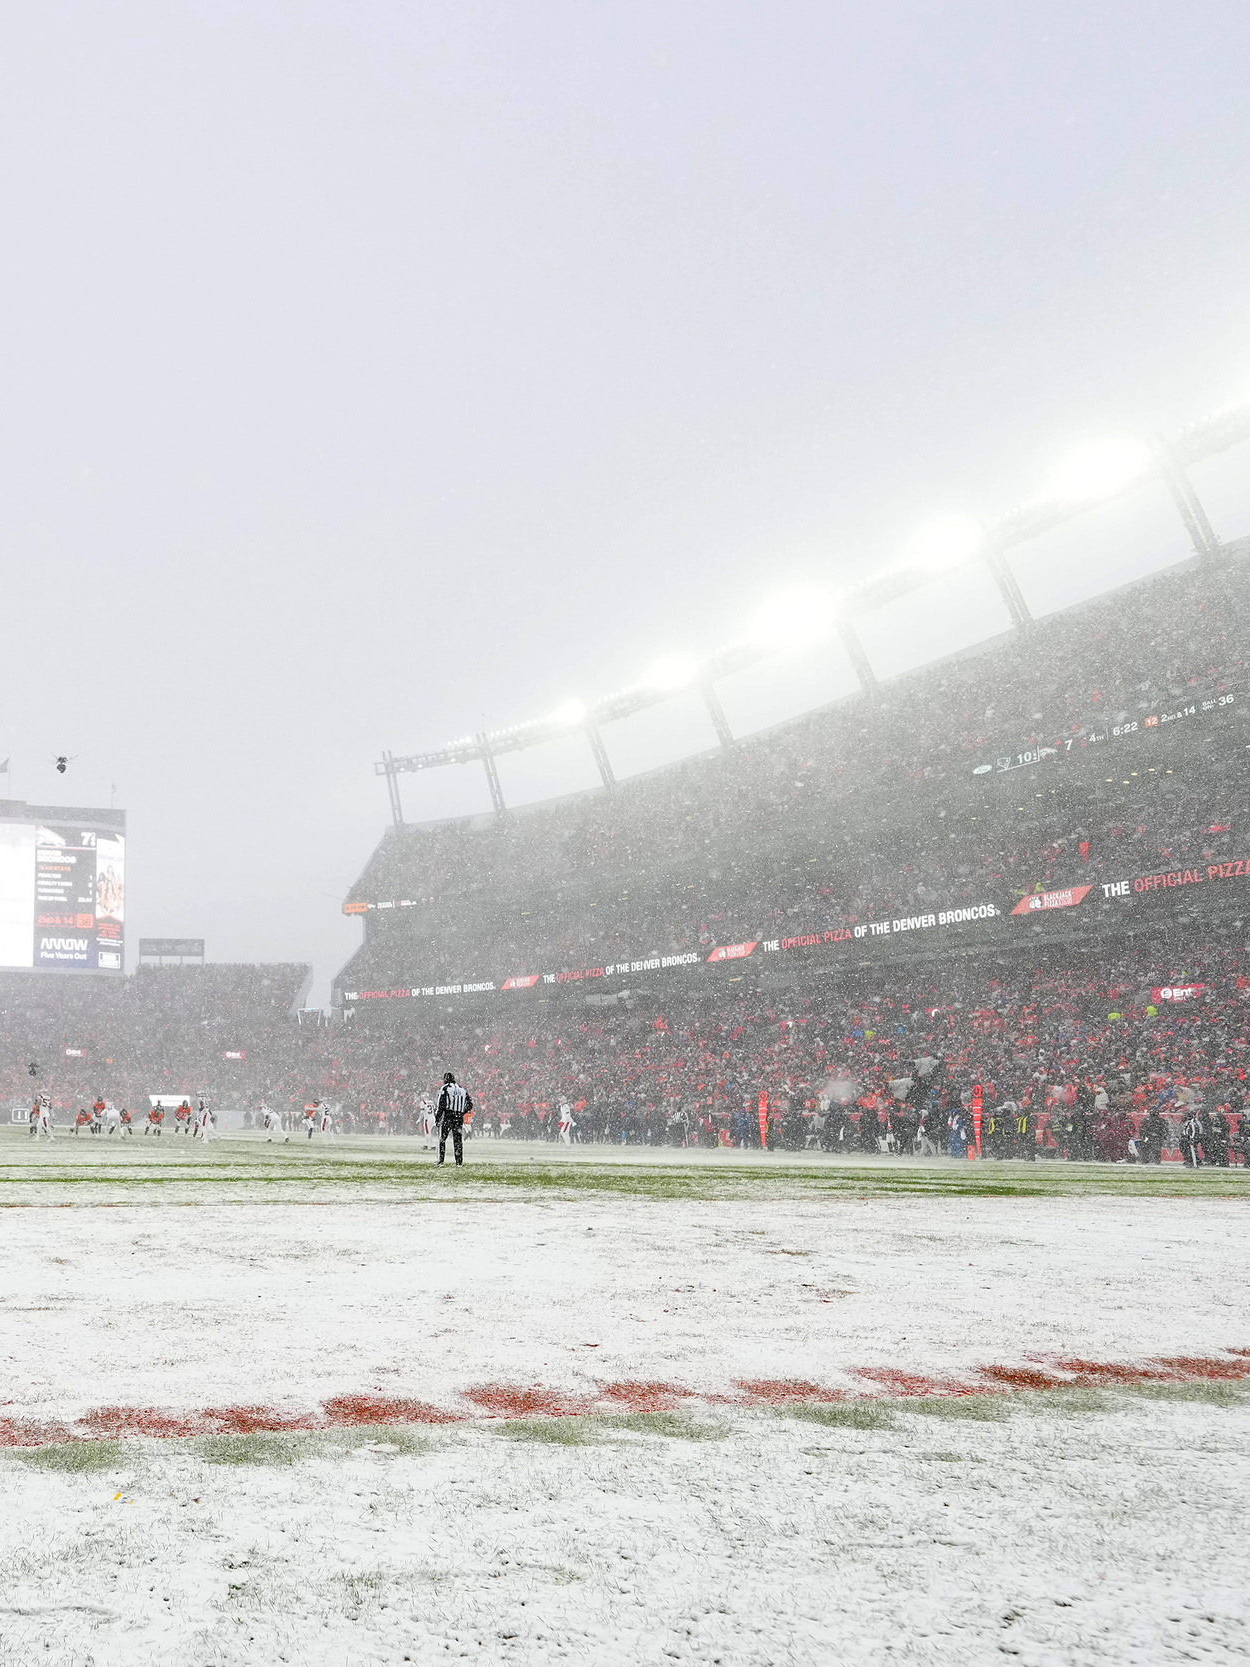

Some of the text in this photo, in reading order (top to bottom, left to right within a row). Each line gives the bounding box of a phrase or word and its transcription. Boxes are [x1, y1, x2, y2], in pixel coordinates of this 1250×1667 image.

[1017, 752, 1031, 763] 10
[1065, 740, 1072, 750] 7
[1113, 722, 1138, 736] 6:22
[1147, 717, 1158, 726] 12
[1184, 706, 1195, 716] 14
[1218, 694, 1234, 706] 36
[81, 832, 91, 845] 7
[1102, 880, 1130, 898] THE
[1134, 869, 1203, 892] OFFICIAL
[763, 940, 779, 952] THE
[781, 934, 821, 949] OFFICIAL
[824, 928, 852, 942] PIZZA
[854, 925, 867, 938] OF
[869, 922, 890, 935] THE
[892, 914, 936, 932] DENVER
[543, 974, 555, 984] THE
[556, 969, 584, 982] OFFICIAL
[585, 967, 605, 977] PIZZA
[605, 965, 615, 975] OF
[616, 963, 630, 974] THE
[631, 959, 660, 972] DENVER
[345, 992, 358, 1000] THE
[359, 990, 389, 999] OFFICIAL
[391, 989, 410, 998] PIZZA
[412, 988, 421, 997] OF
[421, 987, 434, 996] THE
[435, 984, 462, 995] DENVER
[1173, 988, 1192, 997] Ent
[18, 1111, 27, 1119] 11
